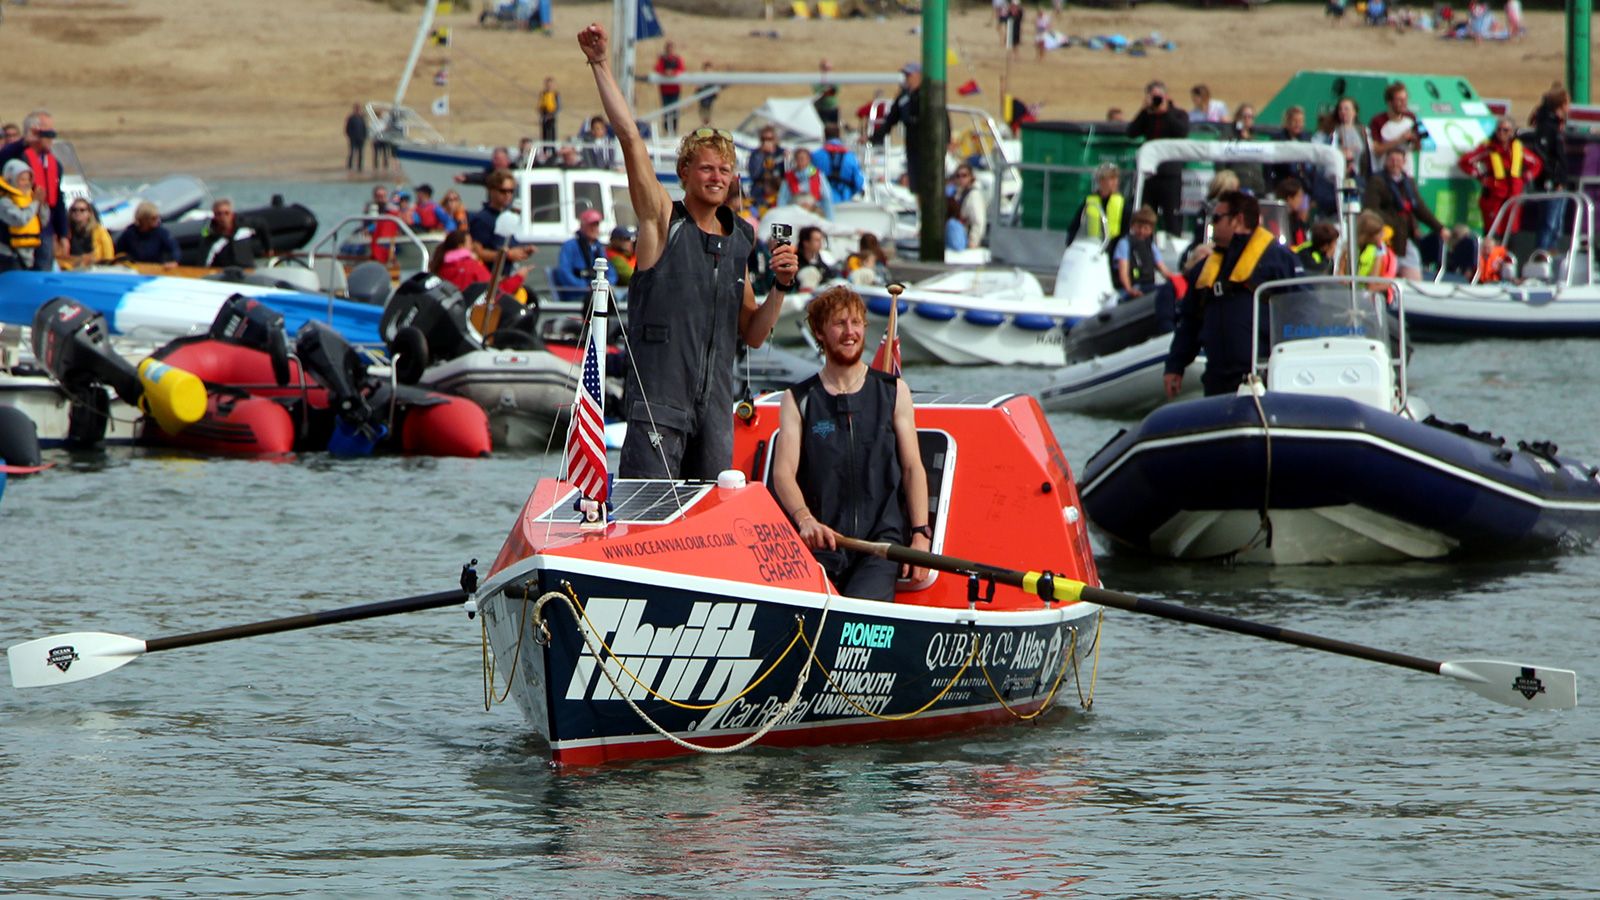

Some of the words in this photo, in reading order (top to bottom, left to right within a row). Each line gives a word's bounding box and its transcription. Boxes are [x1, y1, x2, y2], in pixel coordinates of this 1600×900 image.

[754, 523, 794, 542] BRAIN
[602, 532, 737, 560] WWW.OCEANVALOUR.CO.UK
[748, 541, 804, 563] TUMOUR
[758, 560, 811, 583] CHARITY
[840, 622, 895, 648] PIONEER
[834, 646, 872, 670] WITH
[1010, 631, 1046, 670] Atlas
[823, 670, 897, 694] PLYMOUTH
[719, 696, 760, 729] Car
[813, 693, 893, 716] UNIVERSITY
